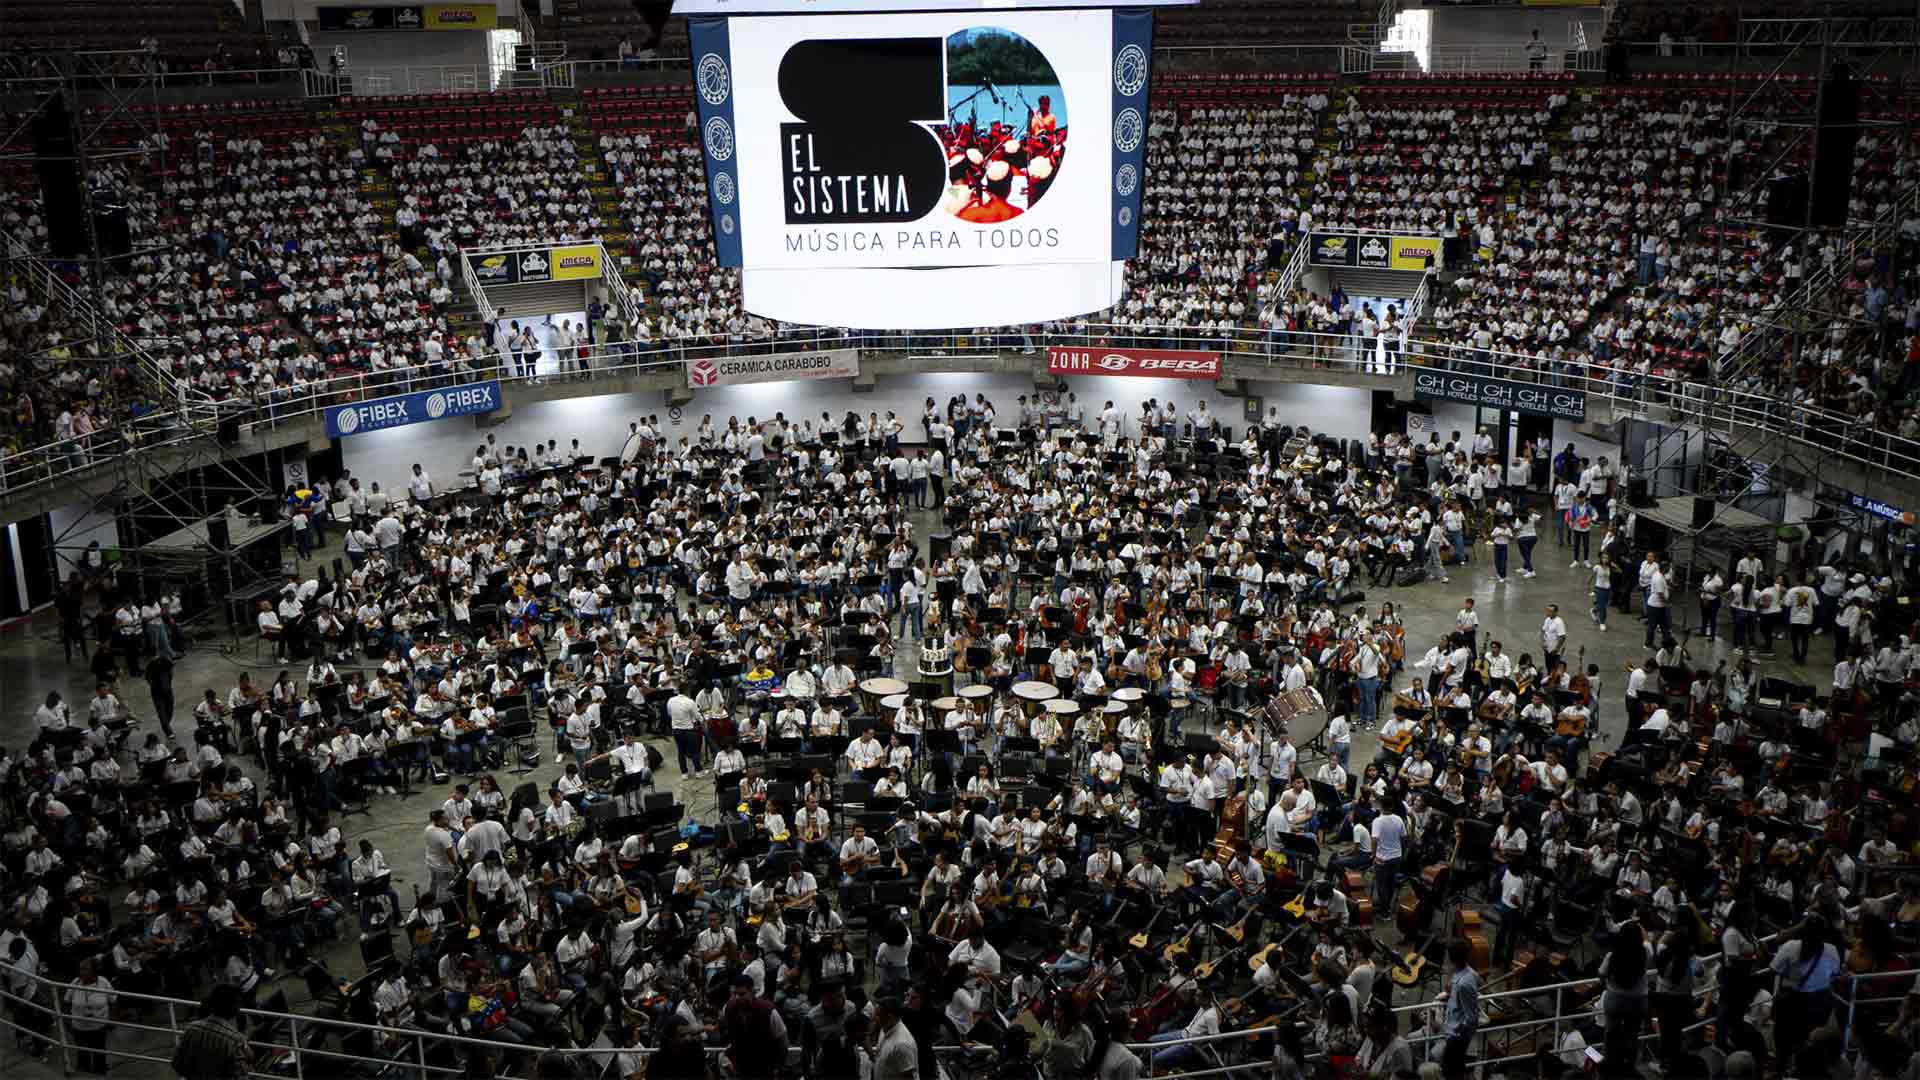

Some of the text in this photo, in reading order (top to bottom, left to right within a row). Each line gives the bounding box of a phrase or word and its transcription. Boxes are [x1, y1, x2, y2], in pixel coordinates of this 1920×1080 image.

[790, 133, 821, 172] EL
[792, 174, 910, 214] SISTEMA
[785, 228, 1060, 252] MÚSICA PARA TODOS
[720, 355, 831, 375] CERAMICA CARABOBO
[1050, 351, 1089, 369] ZONA
[1139, 359, 1217, 370] BERA
[358, 386, 492, 424] FIBEX FIBEX
[1417, 374, 1585, 409] GH GH GH GH GH
